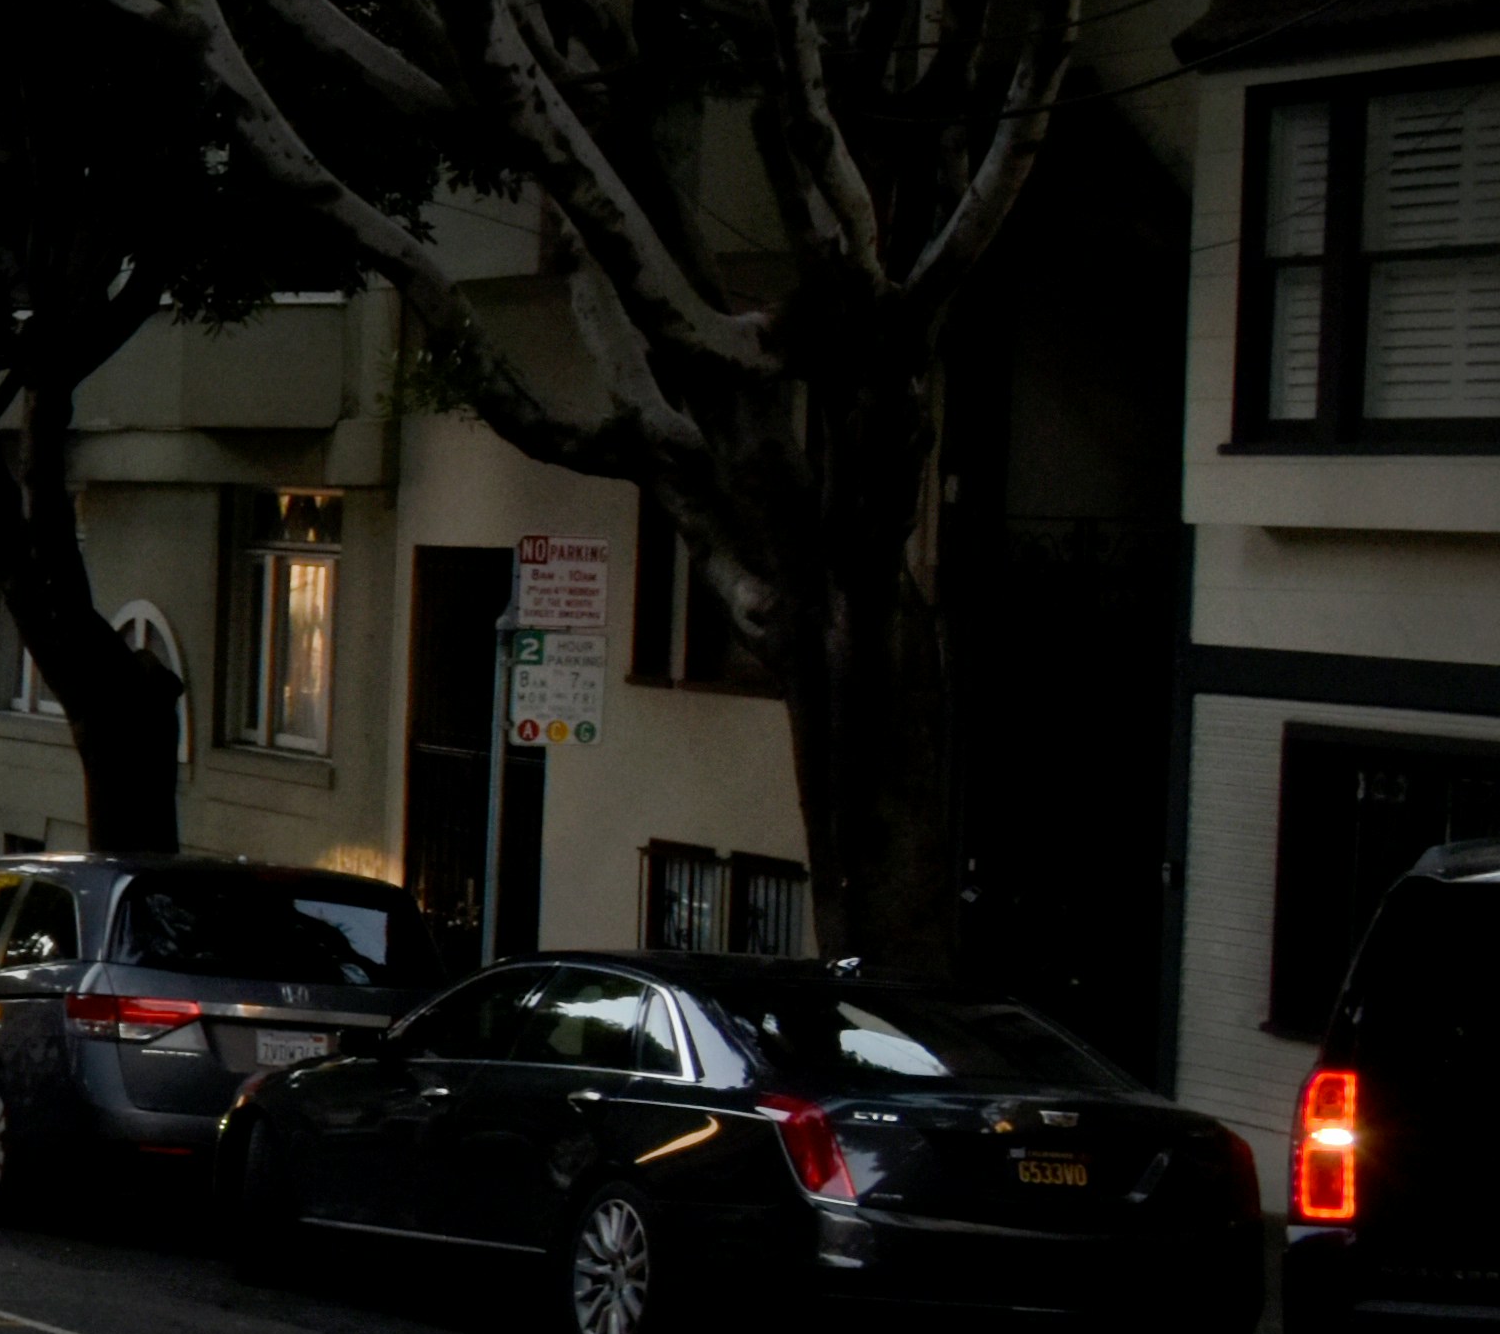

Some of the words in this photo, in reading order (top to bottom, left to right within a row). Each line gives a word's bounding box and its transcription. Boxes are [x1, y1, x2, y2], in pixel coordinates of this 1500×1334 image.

[522, 538, 548, 562] NO
[550, 544, 607, 562] PARKING
[519, 637, 540, 662] 2
